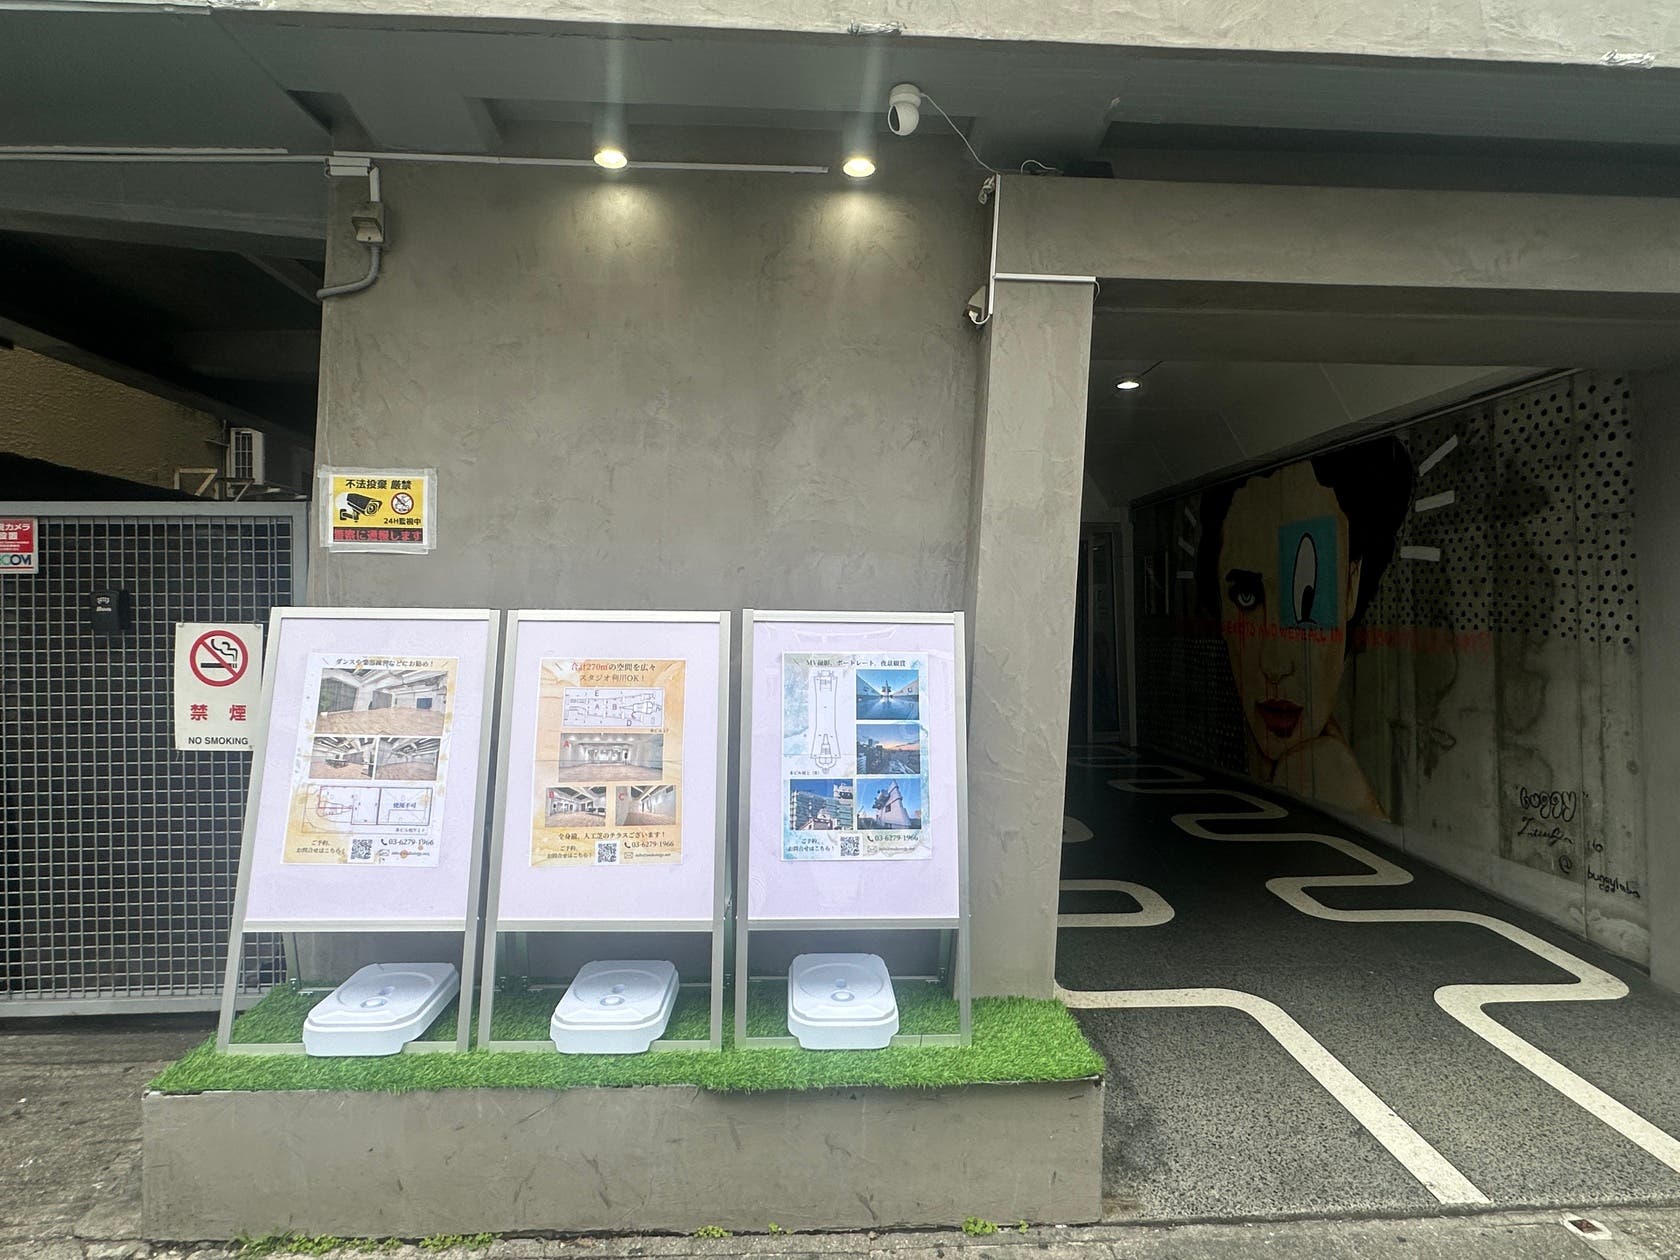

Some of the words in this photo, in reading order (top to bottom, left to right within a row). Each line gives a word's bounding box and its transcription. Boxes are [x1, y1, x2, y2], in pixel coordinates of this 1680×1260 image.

[345, 479, 387, 490] 不法投棄
[391, 480, 412, 490] 厳禁
[383, 517, 421, 526] 24H監視中
[0, 554, 32, 566] COM
[188, 737, 202, 745] NO
[205, 737, 249, 745] SMOKING
